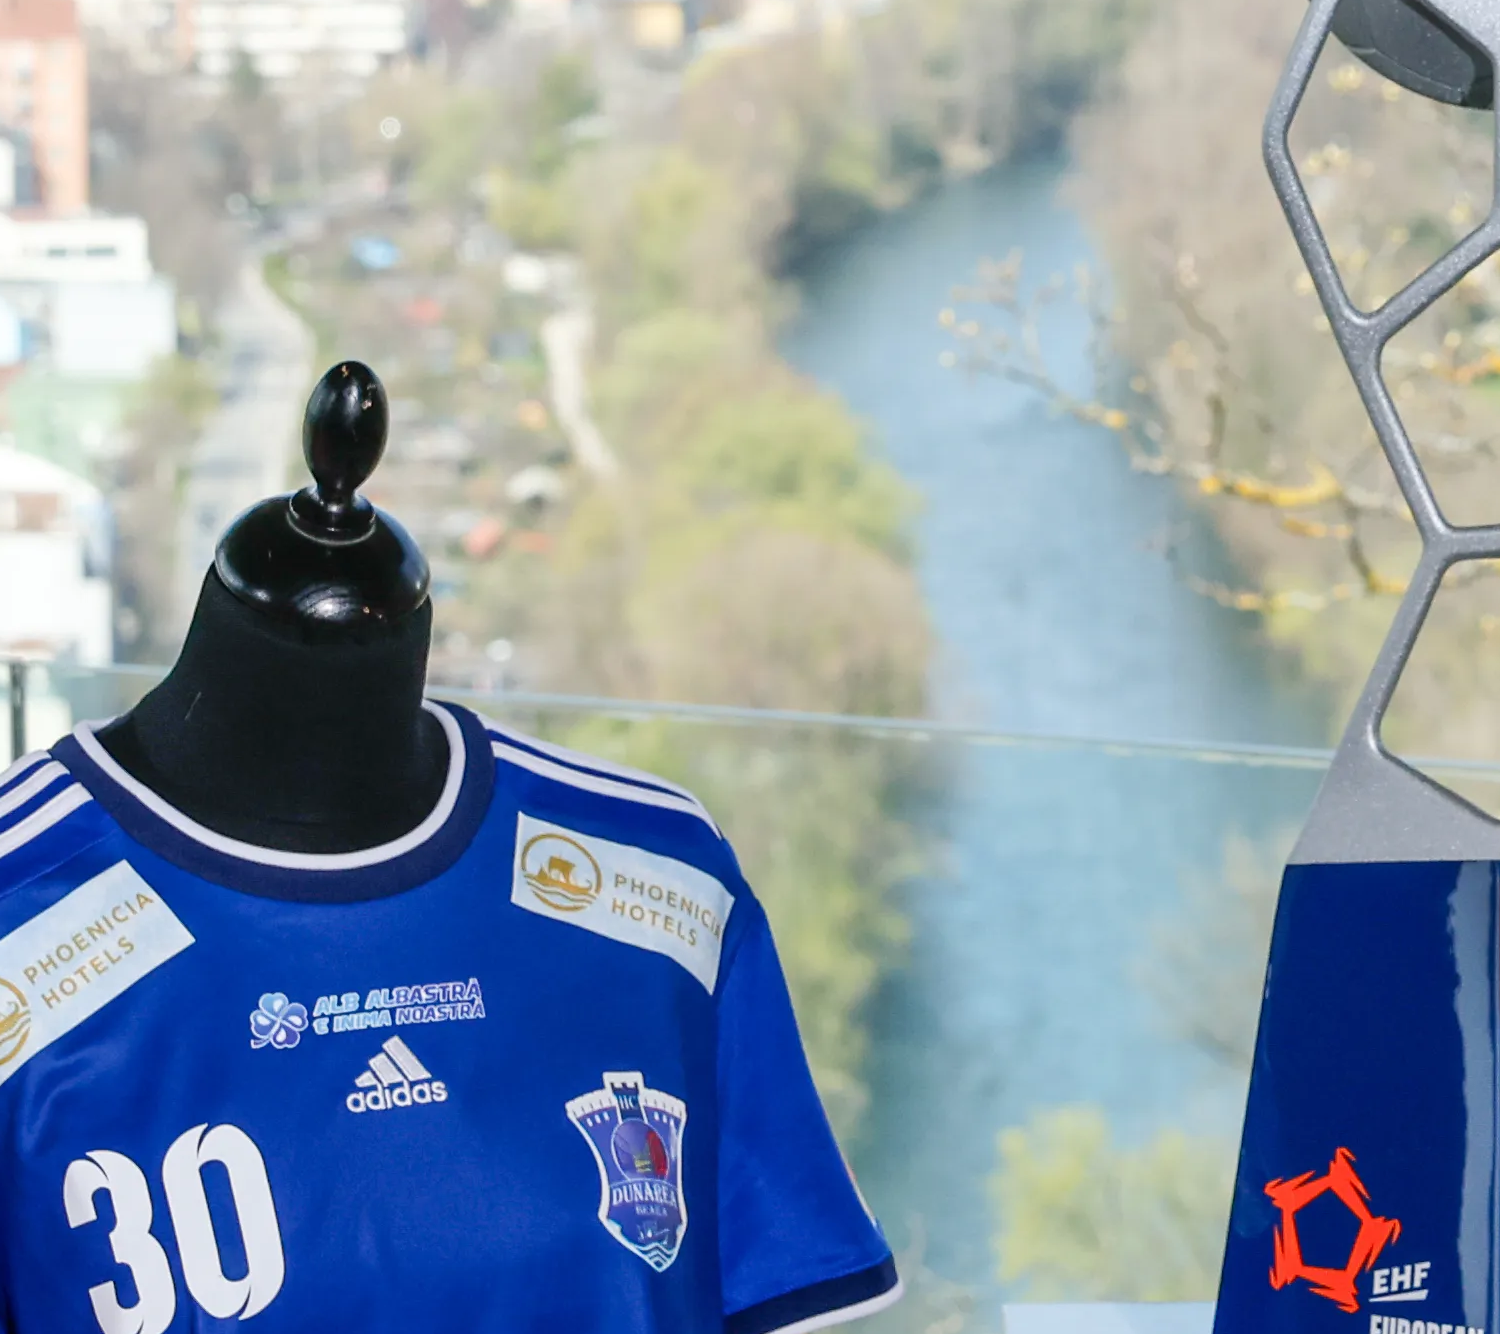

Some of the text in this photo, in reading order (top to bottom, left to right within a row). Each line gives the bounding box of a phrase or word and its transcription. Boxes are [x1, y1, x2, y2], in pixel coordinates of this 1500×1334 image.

[23, 892, 154, 985] PHOENICIA
[612, 897, 698, 946] HOTELS
[41, 936, 135, 1009] HOTELS
[346, 1077, 448, 1113] adidas
[1372, 1261, 1431, 1295] EHF
